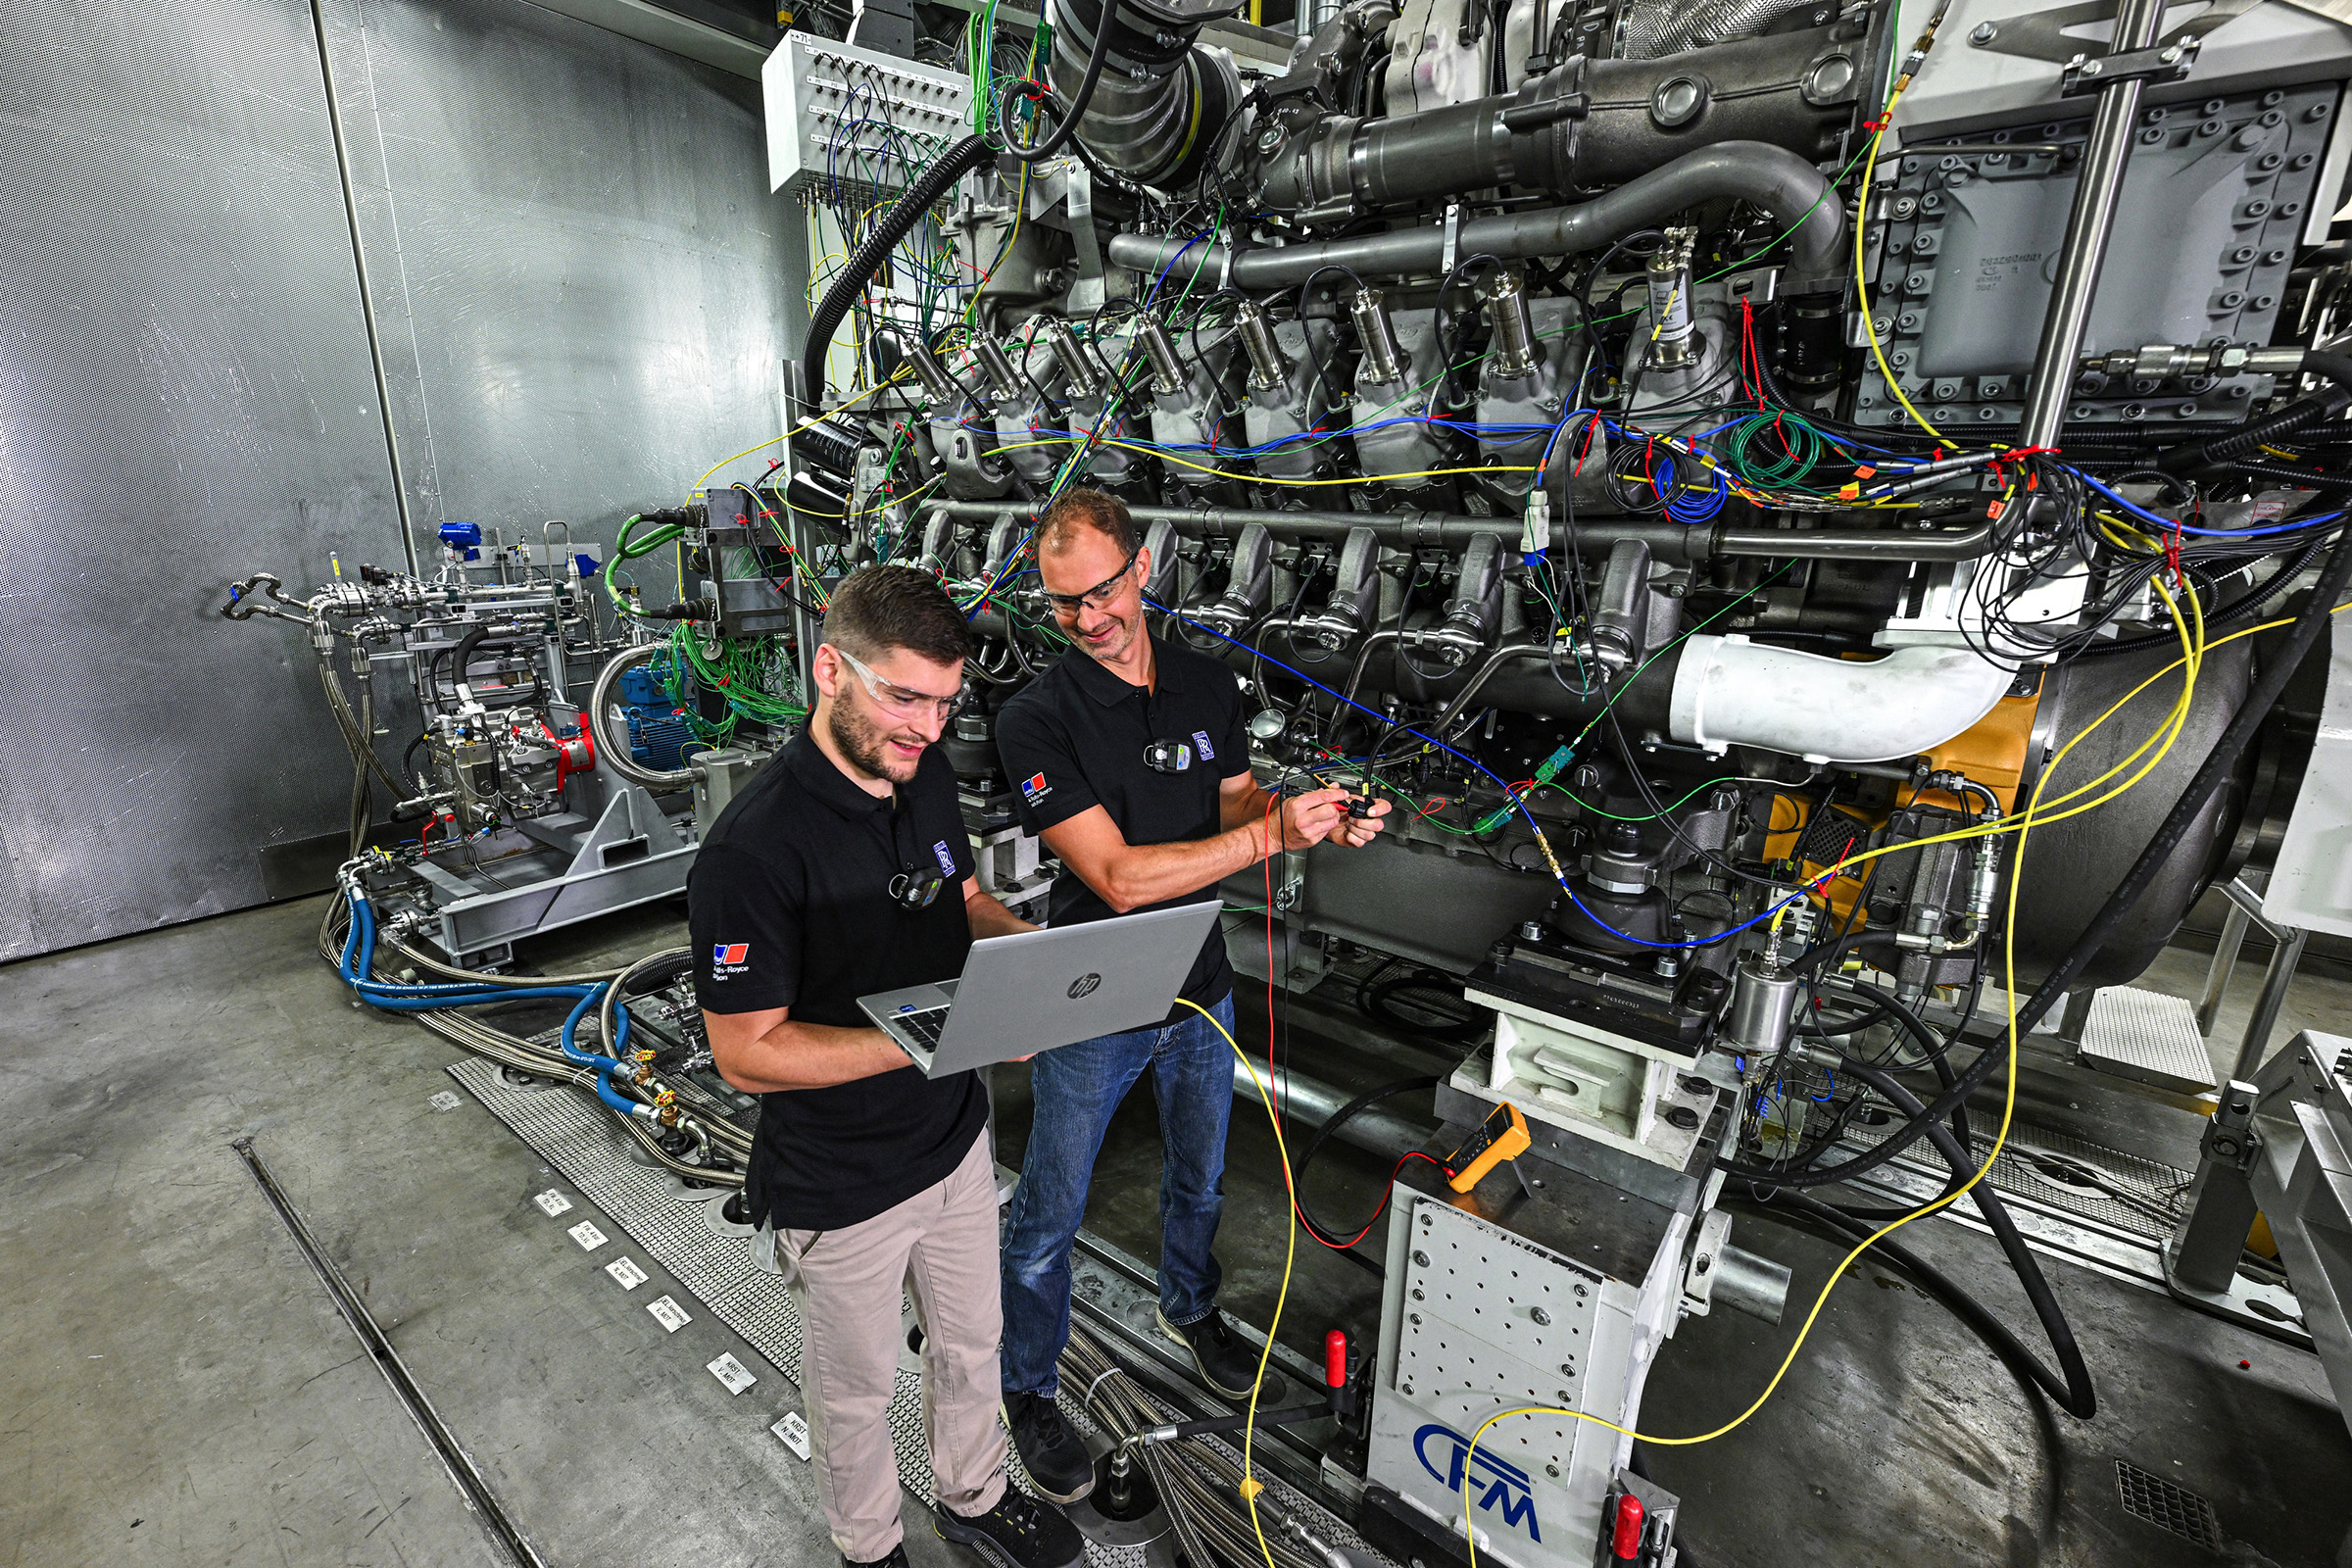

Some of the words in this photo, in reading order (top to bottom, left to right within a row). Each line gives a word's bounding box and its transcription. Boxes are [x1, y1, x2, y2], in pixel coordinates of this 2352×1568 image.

[1069, 974, 1100, 1000] hp
[725, 1360, 741, 1375] KRST
[790, 1419, 808, 1435] KRST
[1412, 1423, 1543, 1544] CFM
